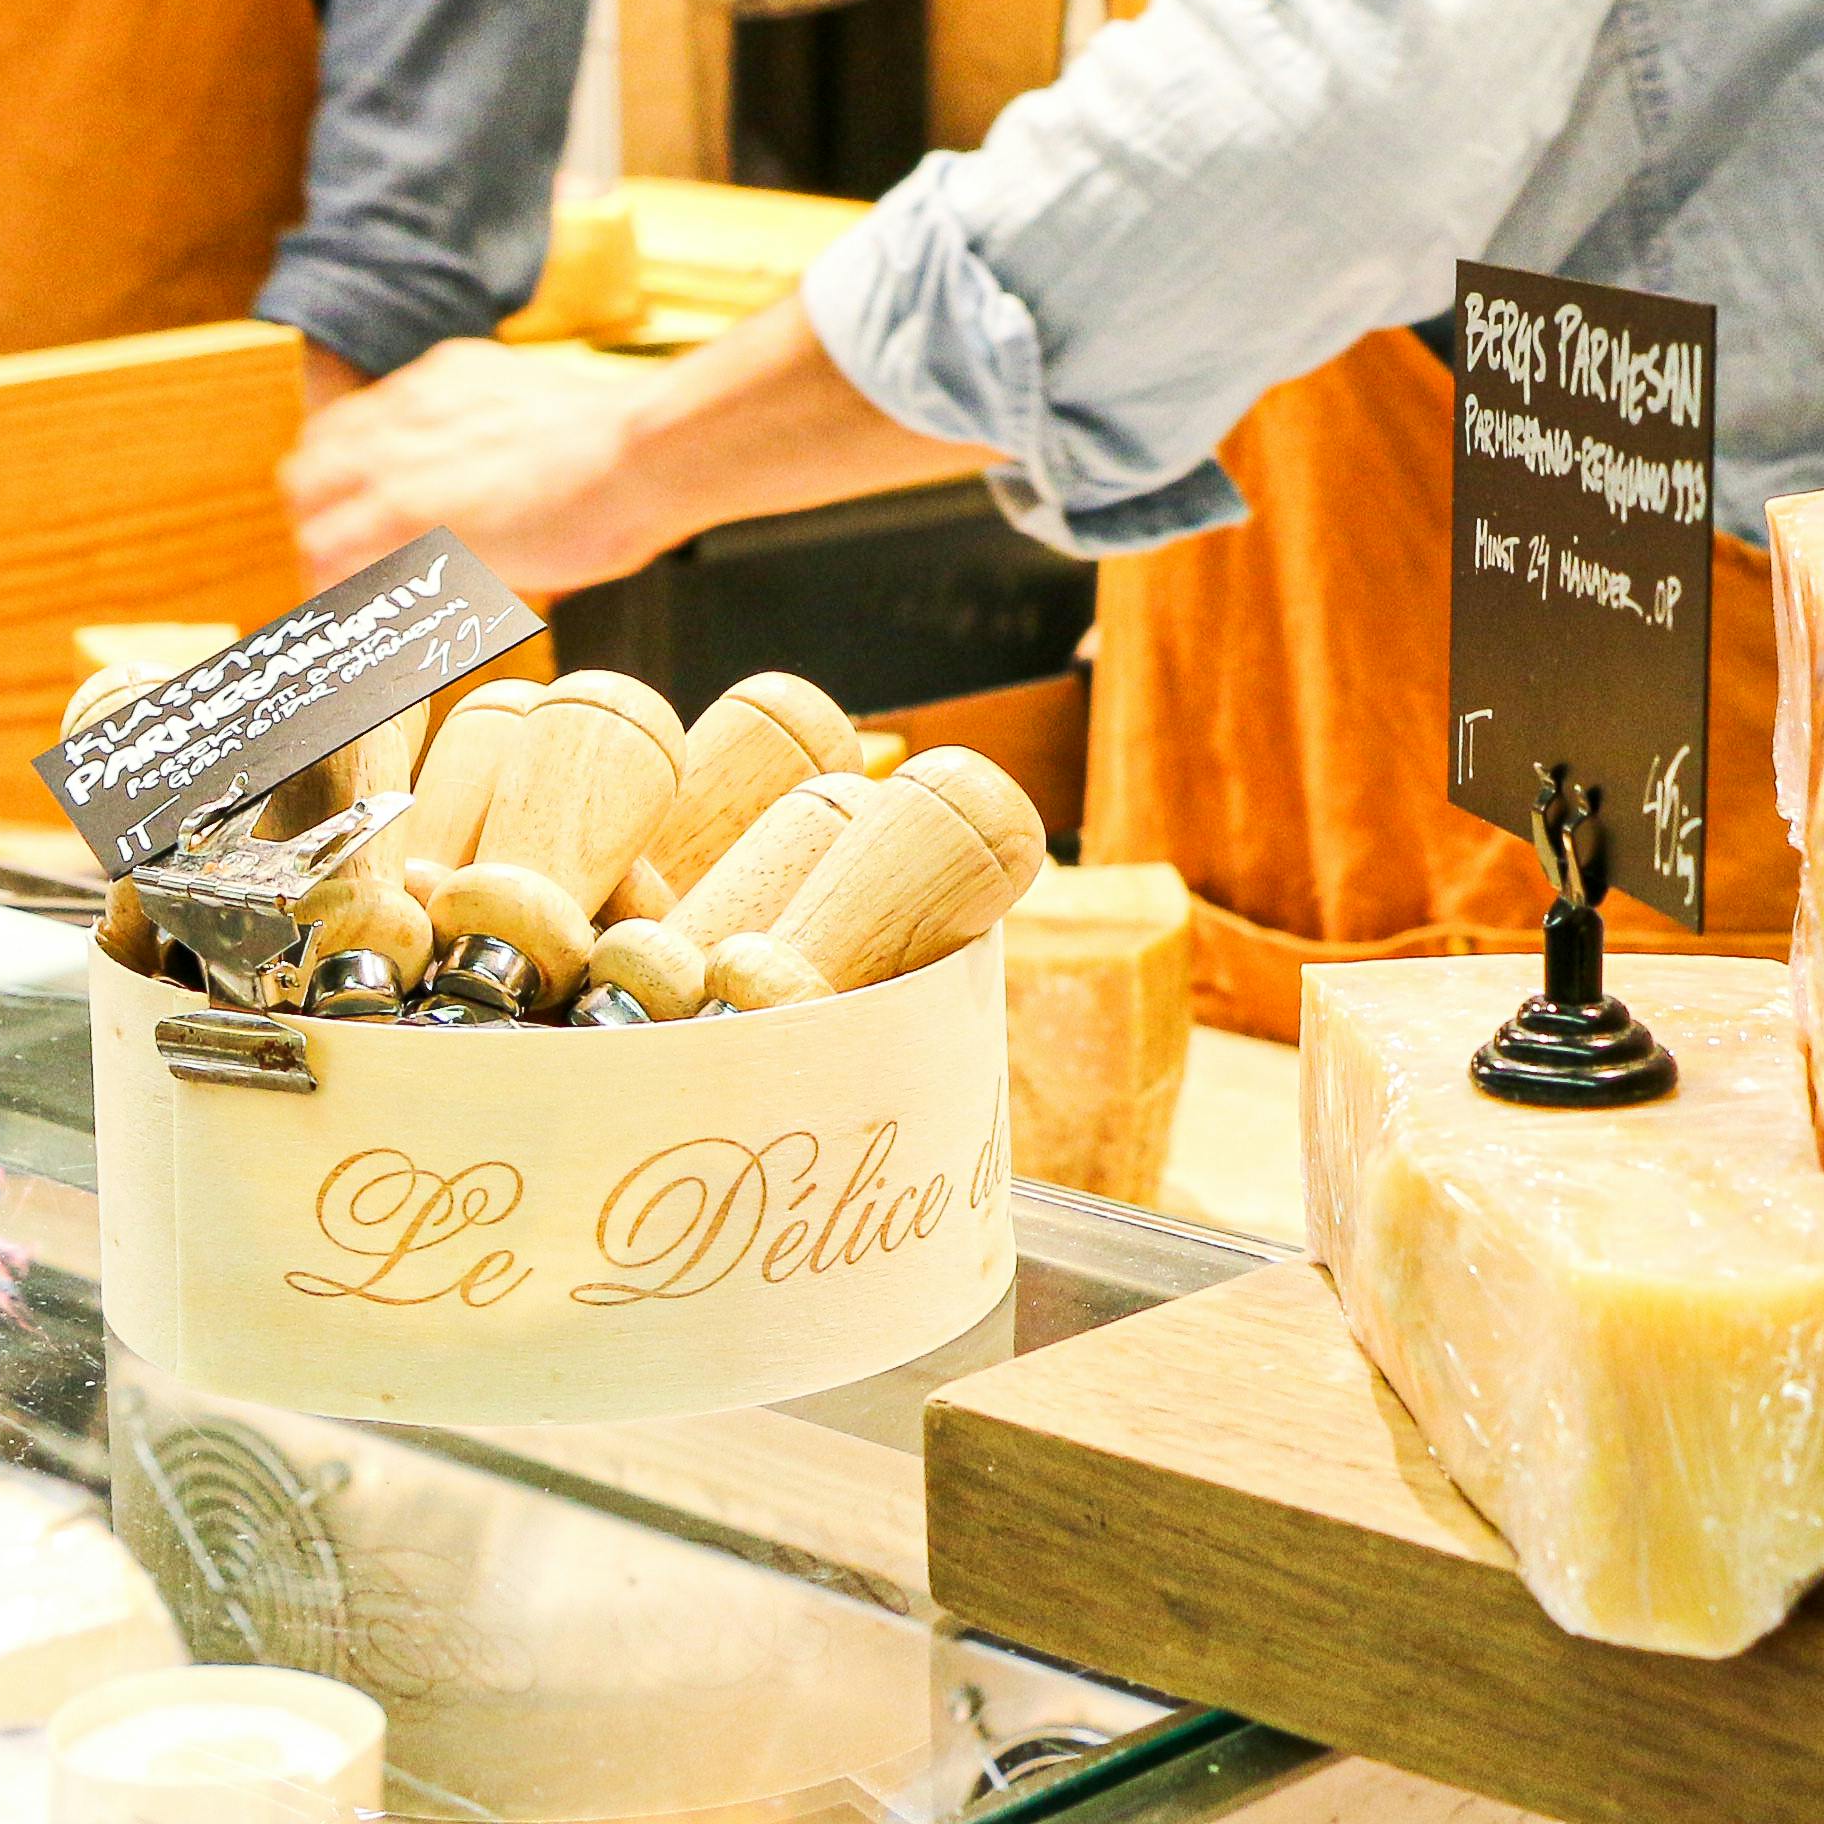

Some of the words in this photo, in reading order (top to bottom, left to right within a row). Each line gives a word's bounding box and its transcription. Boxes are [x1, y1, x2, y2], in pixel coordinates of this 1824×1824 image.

[1464, 291, 1547, 406] BERGS
[1554, 303, 1703, 429] PARMESAN
[1474, 517, 1521, 575] MINST
[1527, 534, 1551, 601] 24
[63, 553, 449, 806] PARMESANKNIV
[125, 716, 247, 800] PERFEKT
[167, 736, 244, 790] GODA
[1457, 707, 1493, 785] IT
[114, 793, 181, 864] IT
[283, 1145, 535, 1308] Le
[569, 1119, 953, 1308] Délice
